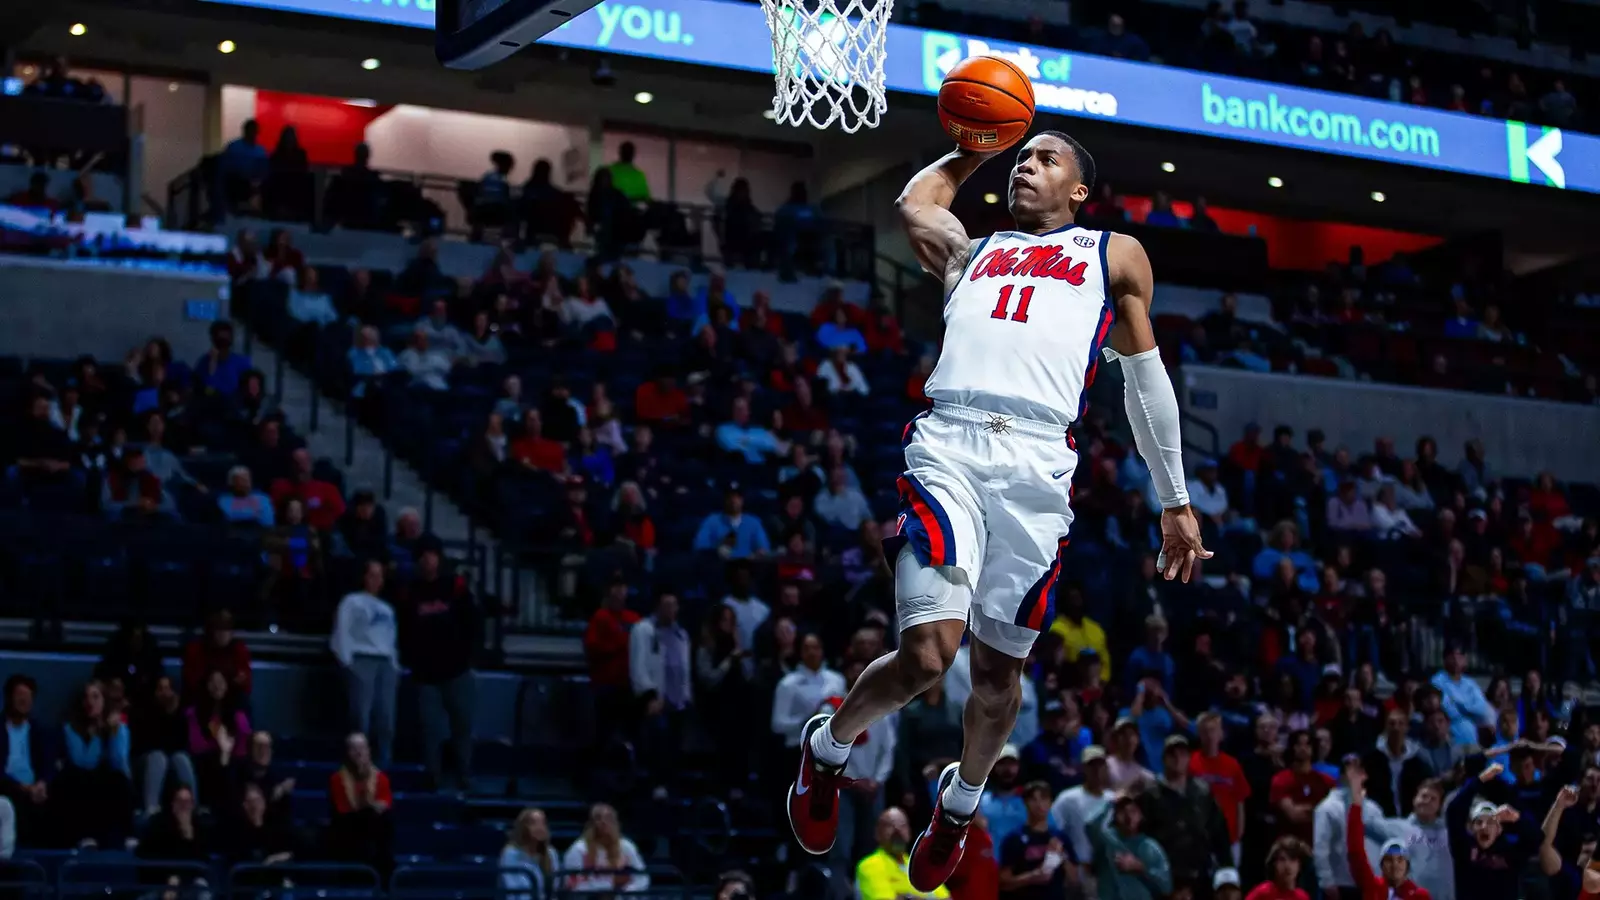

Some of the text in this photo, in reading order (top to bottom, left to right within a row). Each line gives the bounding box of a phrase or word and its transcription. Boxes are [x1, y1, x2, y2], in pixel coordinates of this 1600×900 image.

[597, 4, 694, 46] you.
[1040, 54, 1073, 82] of
[1202, 83, 1440, 157] bankcom.com
[970, 244, 1089, 286] Ole Miss
[990, 284, 1036, 324] 11
